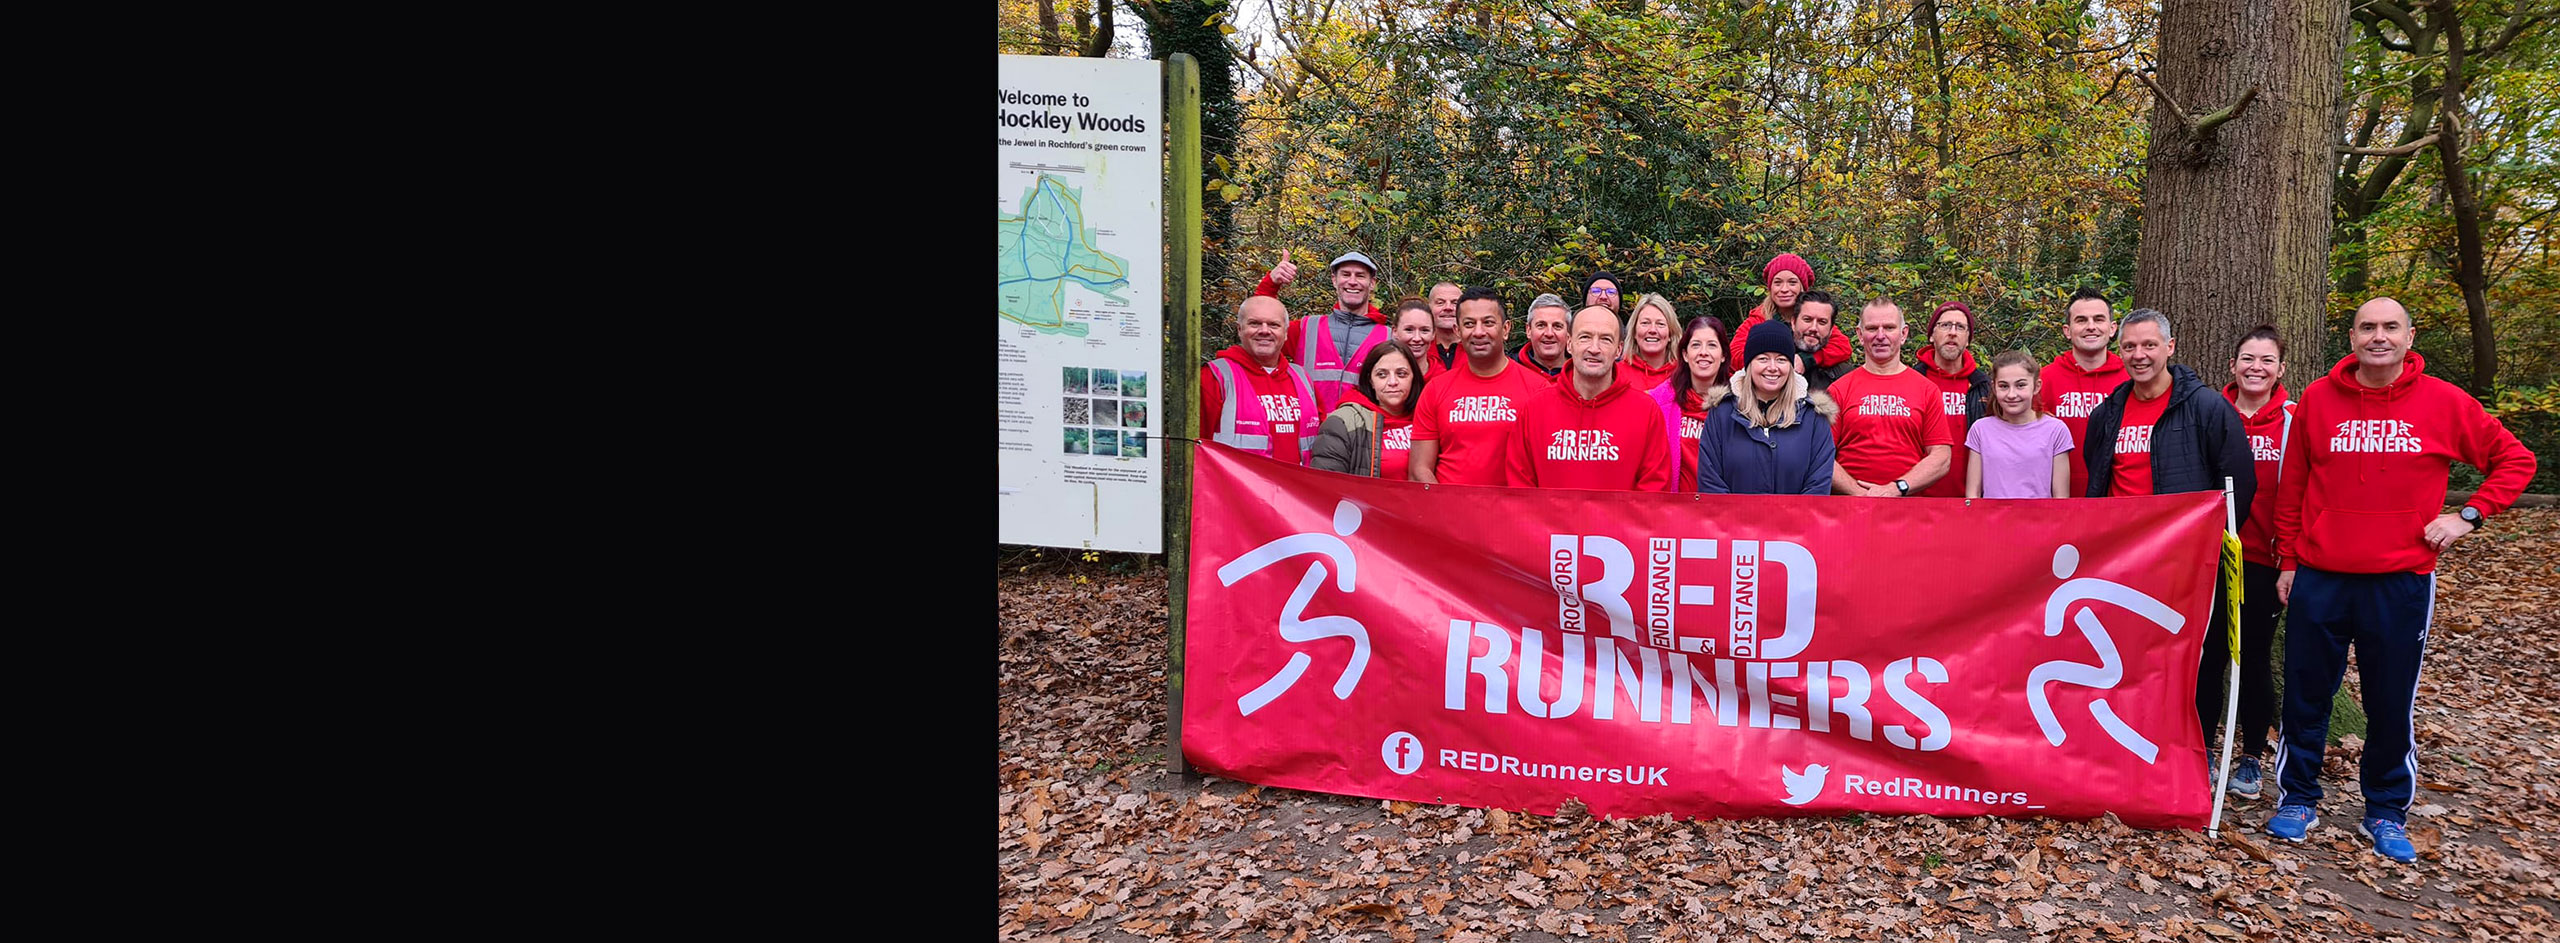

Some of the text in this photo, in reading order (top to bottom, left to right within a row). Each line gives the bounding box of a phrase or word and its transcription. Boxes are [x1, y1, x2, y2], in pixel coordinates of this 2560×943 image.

[1072, 93, 1089, 107] to
[1077, 112, 1145, 133] Woods
[999, 138, 1012, 146] the
[1014, 139, 1036, 147] Jewel
[1048, 140, 1092, 150] Rochford's
[1095, 143, 1118, 152] green
[1120, 144, 1146, 152] crown
[1464, 396, 1499, 411] RED
[1870, 394, 1896, 407] RED
[1942, 391, 1961, 405] ED
[2070, 392, 2103, 409] RED
[1449, 408, 1517, 423] RUNNERS
[1859, 405, 1911, 417] RUNNERS
[2056, 405, 2093, 418] RUNN
[1275, 423, 1295, 433] KEITH
[1392, 424, 1413, 440] RE
[2350, 419, 2398, 438] RED
[1563, 429, 1600, 448] RED
[2329, 436, 2423, 453] RUNNERS
[1547, 446, 1620, 461] RUNNERS
[1550, 534, 1818, 660] RED
[1652, 539, 1672, 649] ENDURANCE
[1733, 554, 1754, 657] DISTANCE
[1444, 618, 1952, 752] RUNNERS
[1439, 748, 1670, 787] REDRunnersUK
[1844, 774, 2046, 809] RedRunners_
